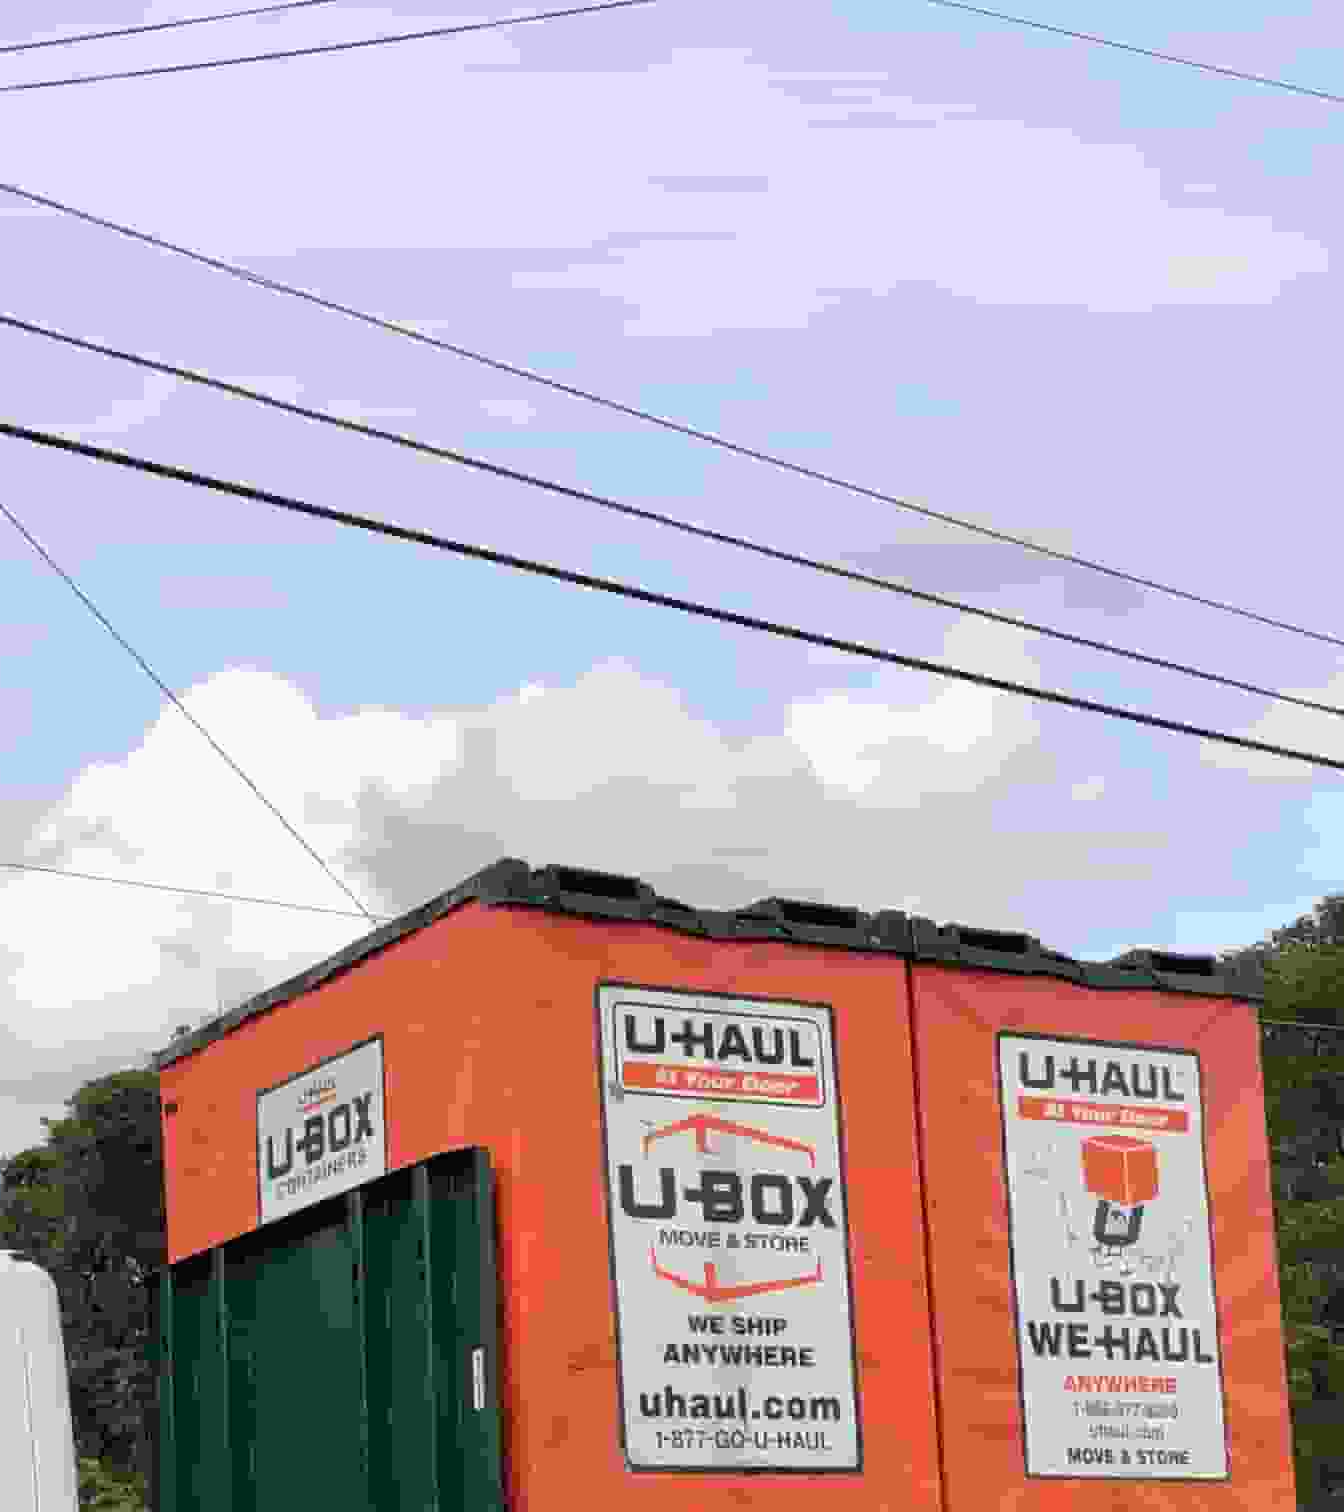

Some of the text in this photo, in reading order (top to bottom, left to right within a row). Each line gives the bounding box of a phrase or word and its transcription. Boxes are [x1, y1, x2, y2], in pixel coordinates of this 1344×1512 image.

[624, 1014, 814, 1067] U-HAUL
[685, 1070, 737, 1090] Your
[741, 1075, 800, 1095] Door
[1018, 1051, 1185, 1101] U-HAUL
[1071, 1105, 1115, 1122] Your
[267, 1092, 373, 1180] U-BOX
[618, 1165, 837, 1229] U-BOX
[659, 1228, 809, 1253] MOVE & STORE
[1050, 1276, 1183, 1319] U-BOX
[688, 1314, 788, 1336] WE SHIP
[1026, 1321, 1214, 1364] WE-HAUL
[663, 1343, 816, 1368] ANYWHERE
[1063, 1375, 1177, 1394] ANYWHERE
[639, 1385, 842, 1424] uhaul.com
[656, 1429, 832, 1452] 1-877-GO-U-HAUL
[1066, 1446, 1114, 1466] MOVE
[1136, 1448, 1191, 1467] STORE
